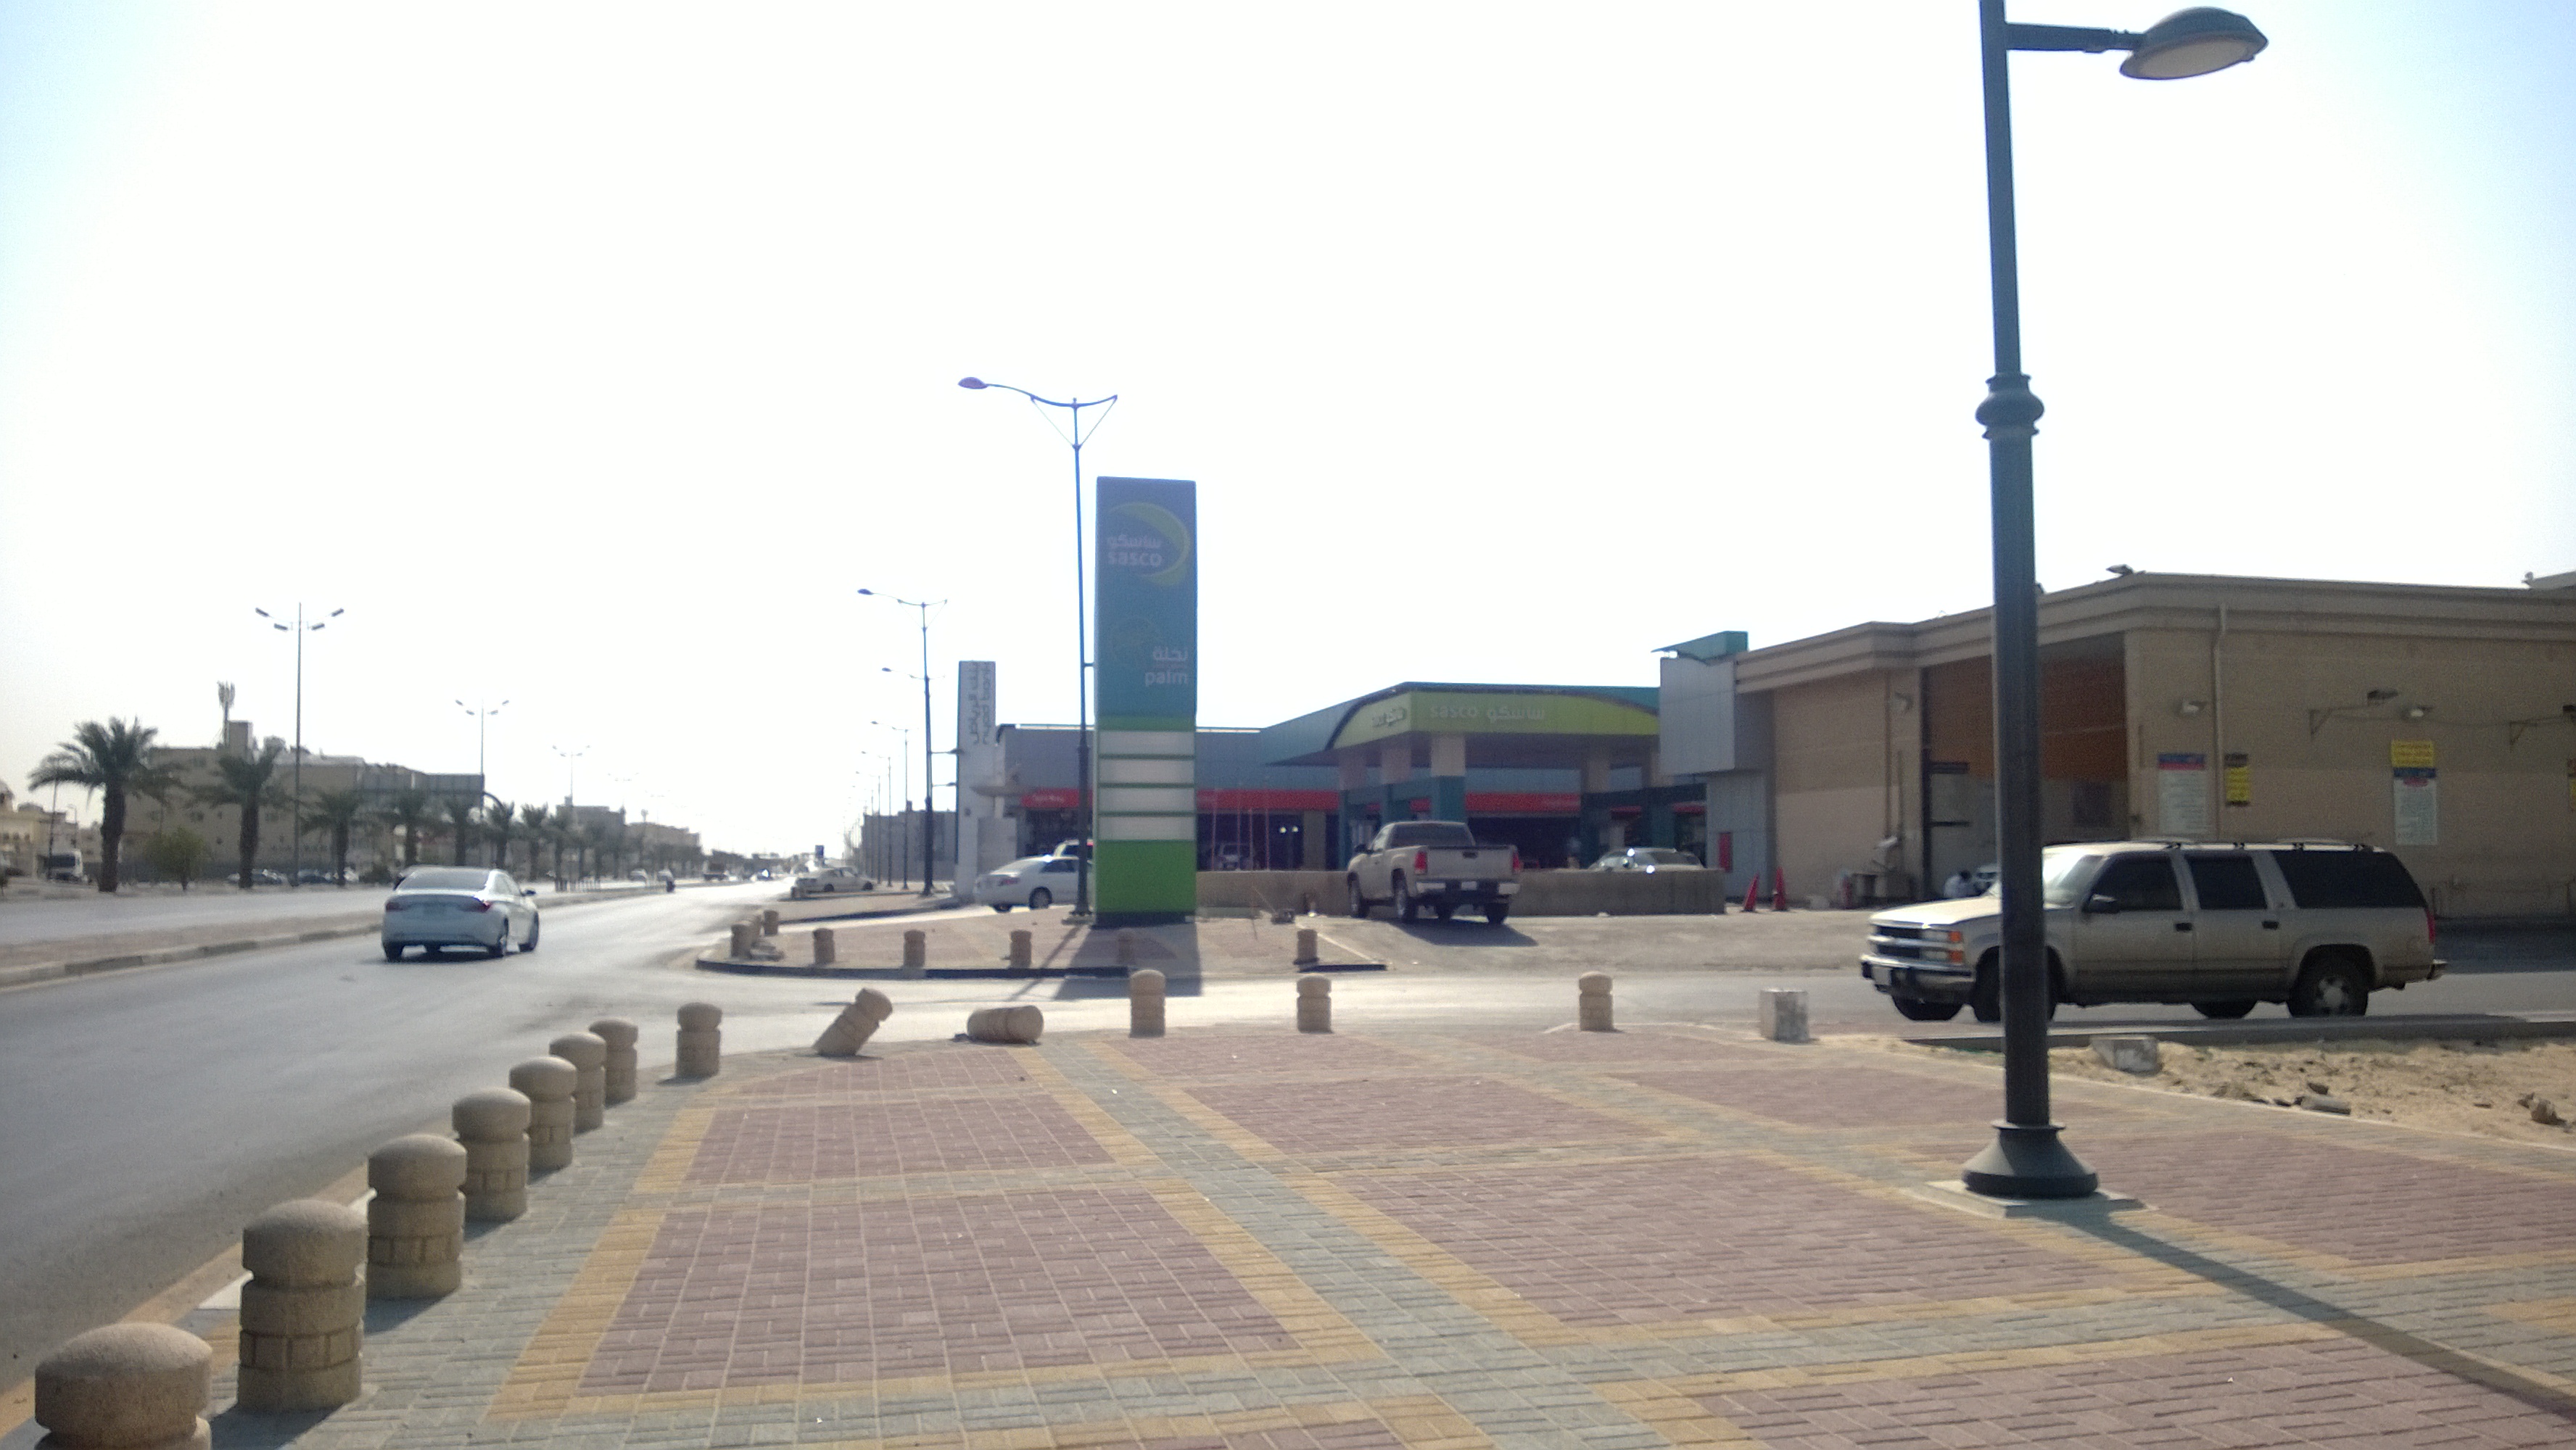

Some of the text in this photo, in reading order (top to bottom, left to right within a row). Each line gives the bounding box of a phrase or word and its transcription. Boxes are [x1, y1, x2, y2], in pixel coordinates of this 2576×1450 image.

[1107, 534, 1162, 549] ساسكو
[1107, 552, 1163, 566] sasco
[1144, 671, 1189, 687] palm
[1430, 706, 1478, 718] sasco
[1487, 706, 1545, 724] ساسكو
